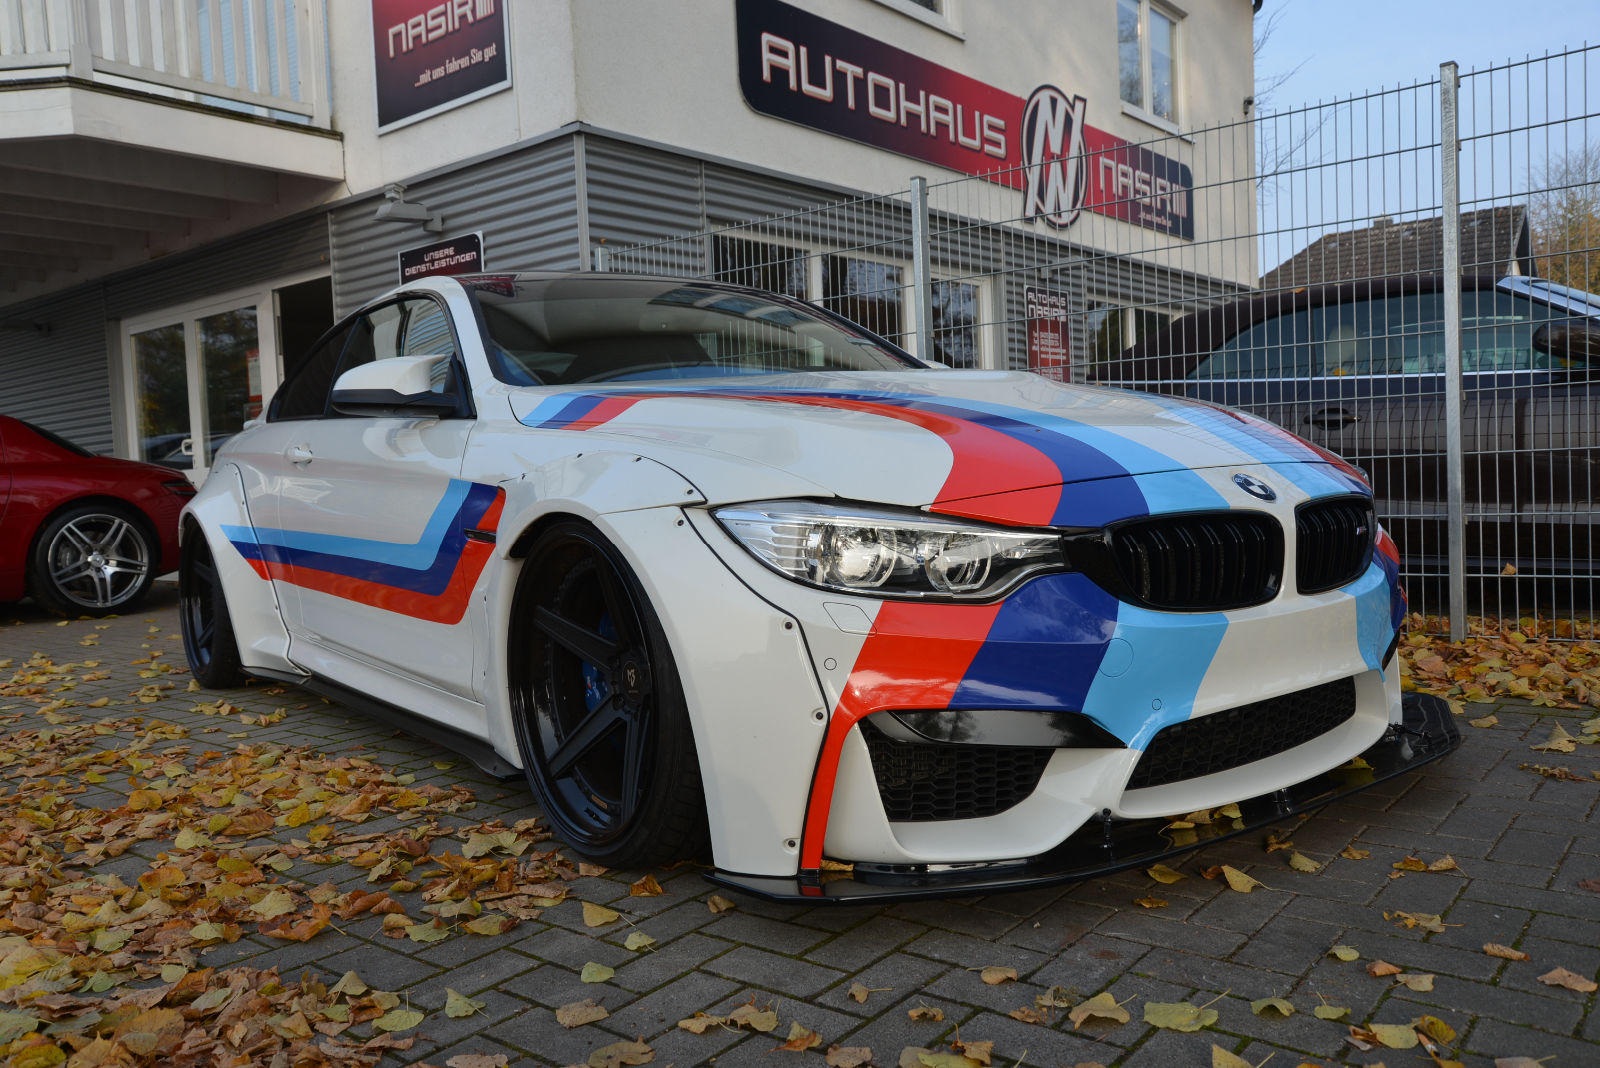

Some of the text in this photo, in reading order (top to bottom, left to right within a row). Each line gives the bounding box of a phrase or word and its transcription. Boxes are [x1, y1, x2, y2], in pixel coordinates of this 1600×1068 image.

[388, 0, 474, 58] NASIR
[432, 65, 445, 79] uns
[446, 56, 469, 74] fahren
[470, 48, 483, 64] Sie
[484, 42, 497, 62] gut
[760, 31, 1007, 159] AUTOHAUS
[1099, 156, 1172, 214] NASIR
[404, 251, 477, 276] DIENSTLEISTUNGEN
[423, 246, 455, 261] UNSERE
